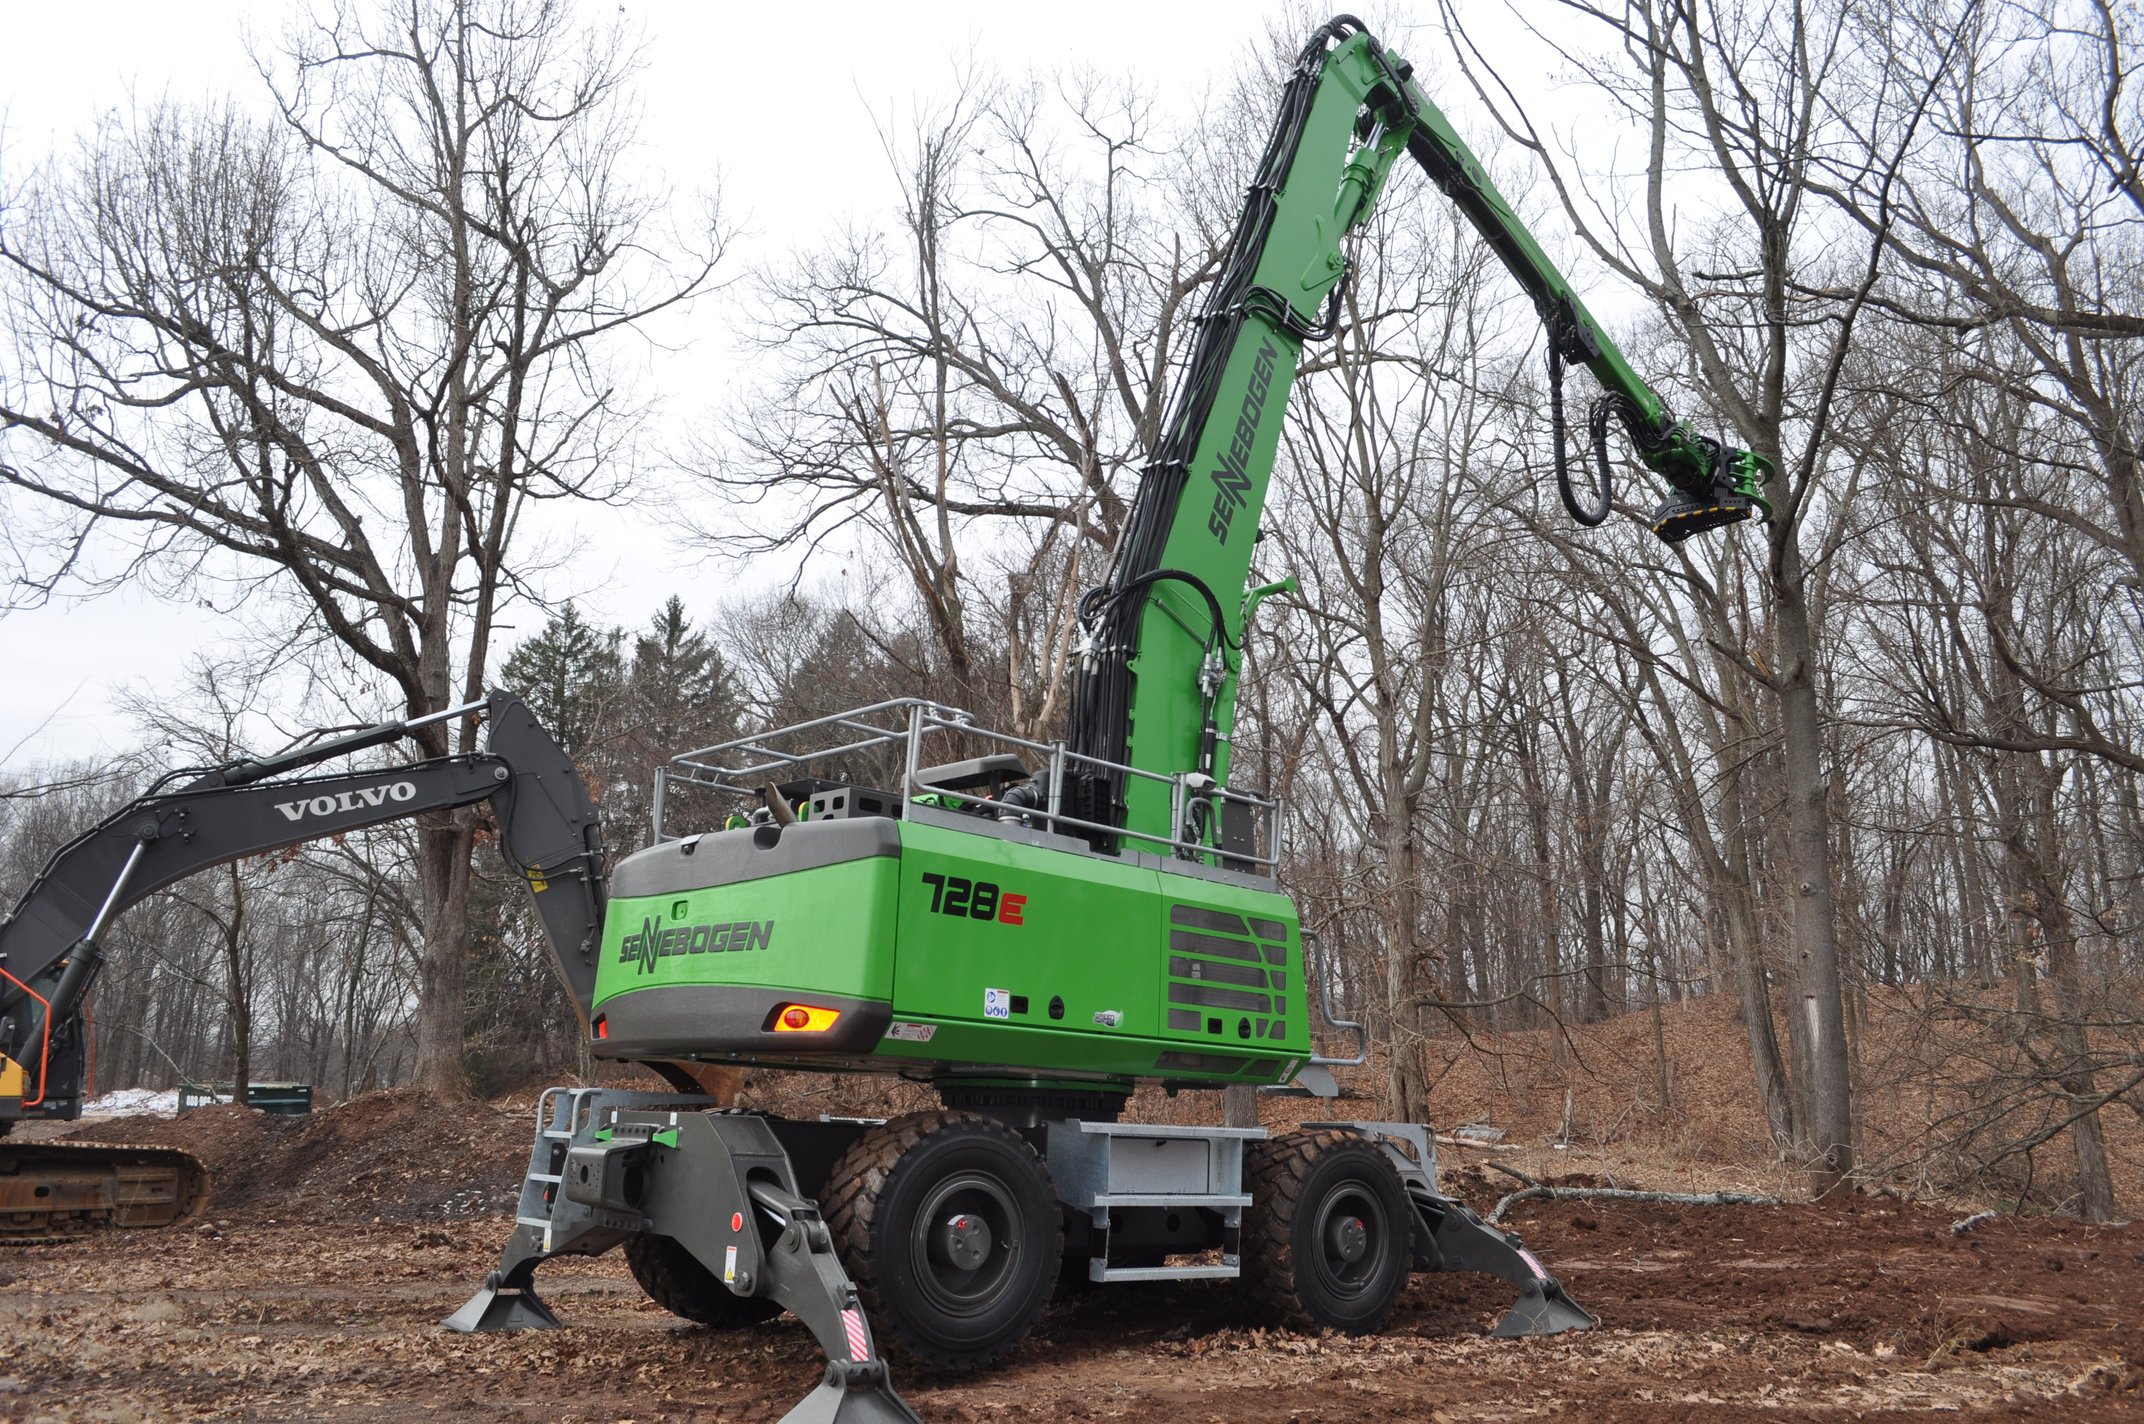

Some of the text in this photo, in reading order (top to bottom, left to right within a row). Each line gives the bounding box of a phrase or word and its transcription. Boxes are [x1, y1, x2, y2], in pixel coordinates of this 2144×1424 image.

[1208, 335, 1279, 547] SENNEBOGEN
[273, 781, 417, 822] VOLVO
[921, 871, 1028, 926] 728E
[619, 915, 775, 976] SENNEBOGEN
